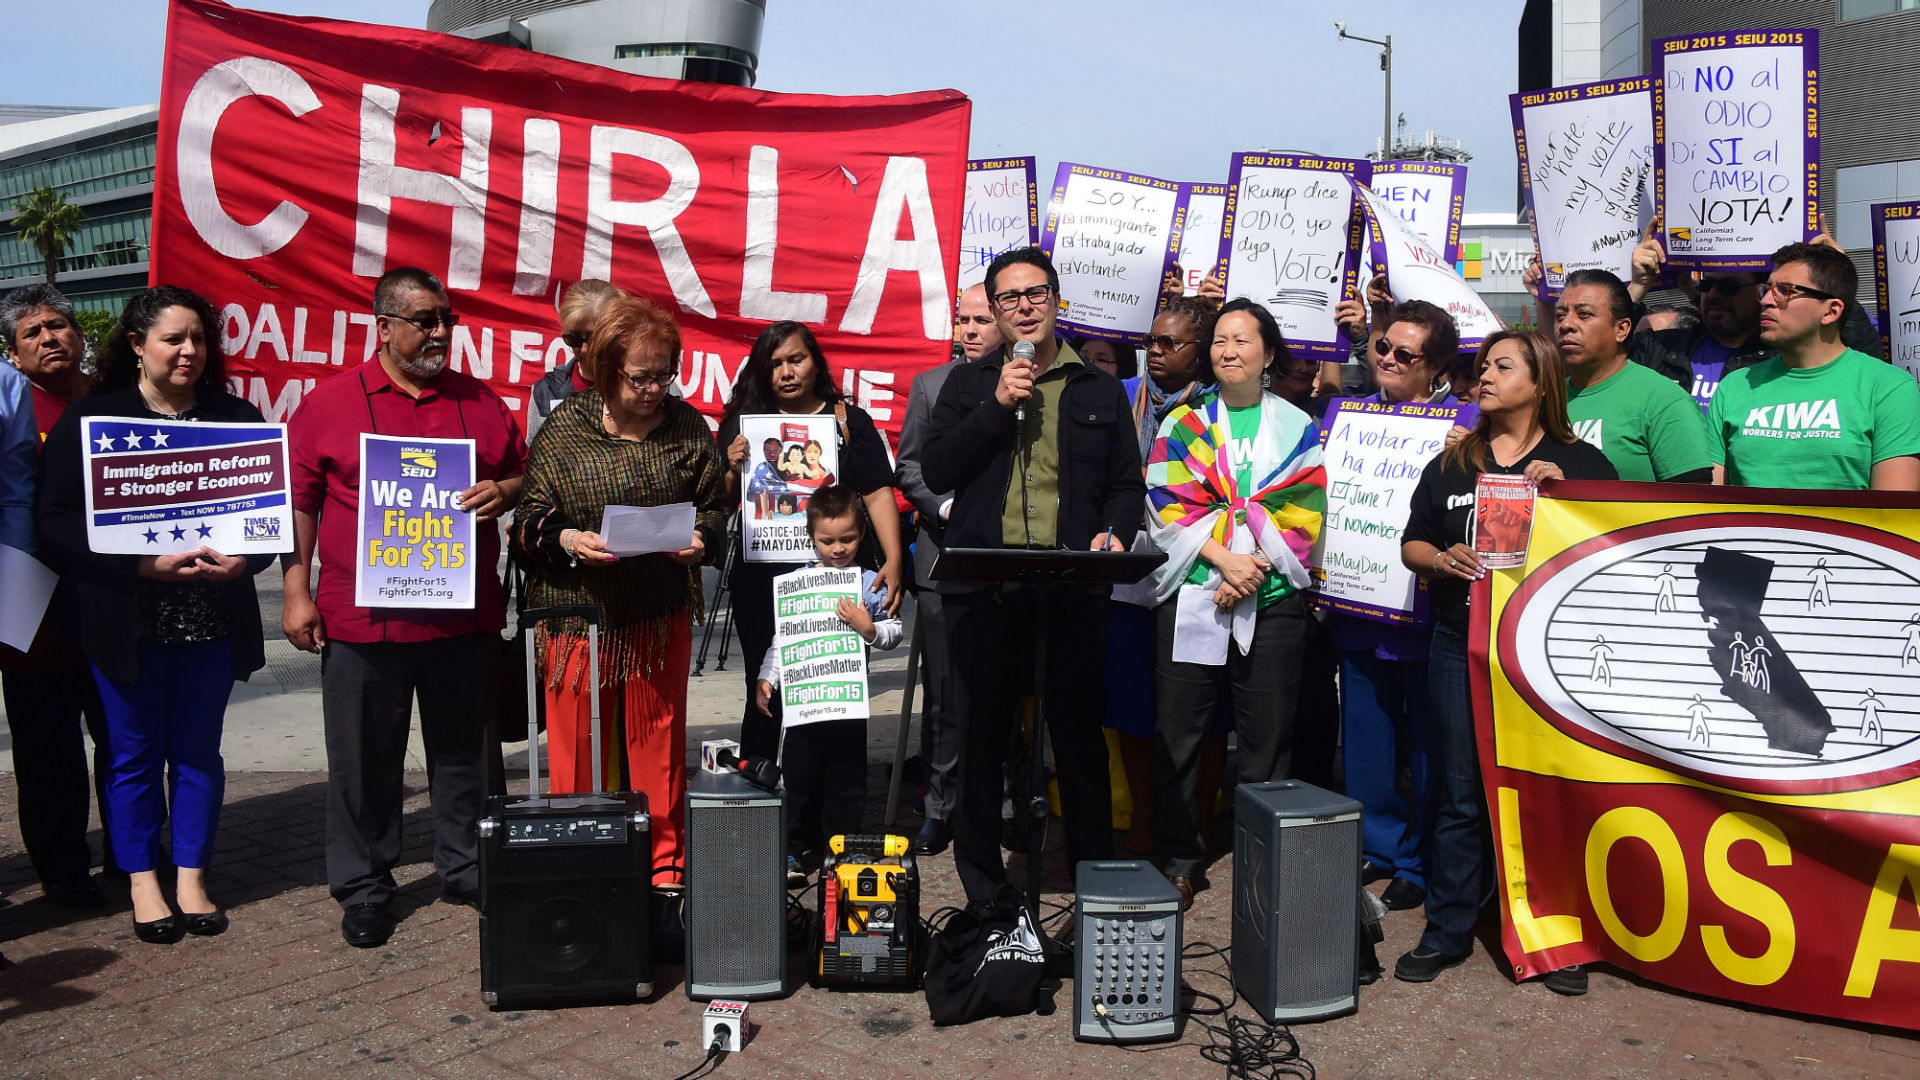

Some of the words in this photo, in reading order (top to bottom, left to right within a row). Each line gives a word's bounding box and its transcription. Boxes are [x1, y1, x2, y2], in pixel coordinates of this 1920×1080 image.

[1664, 40, 1688, 52] SEIU
[1692, 36, 1726, 48] 2015
[1735, 34, 1767, 45] SEIU
[1769, 33, 1803, 44] 2015
[1667, 69, 1685, 91] Di
[1695, 65, 1734, 93] NO
[1751, 57, 1779, 91] al
[1807, 70, 1817, 103] 2015
[1521, 94, 1545, 105] SEIU
[1548, 89, 1579, 102] 2015
[1586, 84, 1615, 97] SEIU
[1618, 79, 1650, 93] 2015
[1655, 78, 1663, 110] 2015
[1704, 100, 1772, 129] ODIO
[1807, 107, 1817, 138] SEIU
[1656, 114, 1664, 144] SEIU
[1517, 129, 1527, 160] 2015
[1671, 141, 1696, 164] Di
[1706, 137, 1743, 166] SI
[1753, 139, 1778, 166] al
[983, 161, 1002, 169] SEIU
[1004, 159, 1026, 168] 2015
[1243, 156, 1264, 166] SEIU
[1267, 157, 1293, 167] 2015
[1299, 158, 1323, 169] SEIU
[1326, 161, 1355, 171] 2015
[1373, 164, 1395, 173] 2015
[1401, 164, 1425, 173] SEIU
[1427, 165, 1454, 175] 2015
[1522, 163, 1531, 188] SEIU
[1565, 175, 1604, 211] my
[1588, 120, 1625, 169] vote
[1071, 166, 1094, 176] SEIU
[1096, 170, 1122, 180] 2015
[1127, 175, 1150, 186] SEIU
[1153, 180, 1179, 191] 2015
[1303, 180, 1338, 200] dice
[1609, 165, 1635, 201] June
[1628, 157, 1652, 215] November
[1692, 169, 1790, 195] CAMBIO
[1808, 163, 1817, 195] 2015
[177, 56, 953, 340] CHIRLA
[1227, 185, 1237, 211] 2015
[1374, 186, 1431, 203] HEN
[1453, 195, 1462, 220] 2015
[1174, 206, 1185, 229] 2015
[1689, 197, 1793, 226] VOTA!
[1808, 200, 1817, 231] SEIU
[1885, 207, 1912, 218] SEIU
[980, 212, 1026, 239] Hope
[1224, 212, 1232, 239] SEIU
[1306, 219, 1331, 237] yo
[1350, 224, 1360, 250] SEIU
[1370, 219, 1382, 243] SEIU
[1449, 219, 1460, 246] SEIU
[1077, 232, 1146, 256] trabajador
[1170, 229, 1180, 253] SEIU
[1238, 236, 1270, 262] digo
[1591, 227, 1642, 253] #MayDay
[1671, 240, 1691, 248] SEIU
[1877, 244, 1886, 278] 2015
[1093, 289, 1140, 307] #MAYDAY
[1879, 281, 1887, 311] SEIU
[221, 302, 493, 380] OALITN
[1340, 401, 1365, 411] SEIU
[1366, 402, 1394, 413] 2015
[1400, 406, 1427, 416] SEIU
[1428, 407, 1458, 418] 2015
[1744, 399, 1841, 430] KIWA
[1336, 423, 1350, 442] A
[1359, 427, 1413, 449] votar
[1417, 440, 1441, 454] se
[1742, 429, 1783, 439] WORKERS
[1786, 431, 1801, 440] FOR
[1804, 429, 1841, 439] JUSTICE
[103, 460, 204, 479] Immigration
[208, 454, 271, 472] Reform
[401, 468, 437, 478] SEIU
[1341, 450, 1363, 472] ha
[1373, 459, 1421, 480] dicho
[120, 479, 193, 496] Stronger
[197, 471, 273, 491] Economy
[371, 480, 413, 508] We
[420, 483, 464, 511] Are
[1349, 486, 1379, 508] June
[1384, 489, 1394, 506] 7
[121, 511, 165, 522] #TimeIsNow
[181, 508, 195, 516] Text
[196, 505, 216, 515] NOW
[217, 505, 225, 513] to
[227, 500, 256, 511] 787753
[244, 517, 269, 526] TIME
[270, 517, 280, 525] IS
[244, 525, 280, 537] NOW
[383, 510, 454, 544] Fight
[1344, 516, 1399, 539] November
[368, 539, 413, 567] For
[420, 540, 466, 571] $15
[1324, 552, 1388, 583] #MayDay
[379, 588, 453, 599] FightFor15.org
[386, 577, 447, 587] #FightFor15
[777, 572, 857, 597] #BlackLivesMatter
[784, 636, 857, 663] #FightFor15
[784, 659, 862, 685] #BlackLivesMatter
[788, 684, 861, 703] #FightFor15
[800, 706, 847, 719] FightFor15.org
[1498, 787, 1796, 986] LOS
[987, 952, 1011, 961] NEW
[1014, 952, 1044, 963] PRESS
